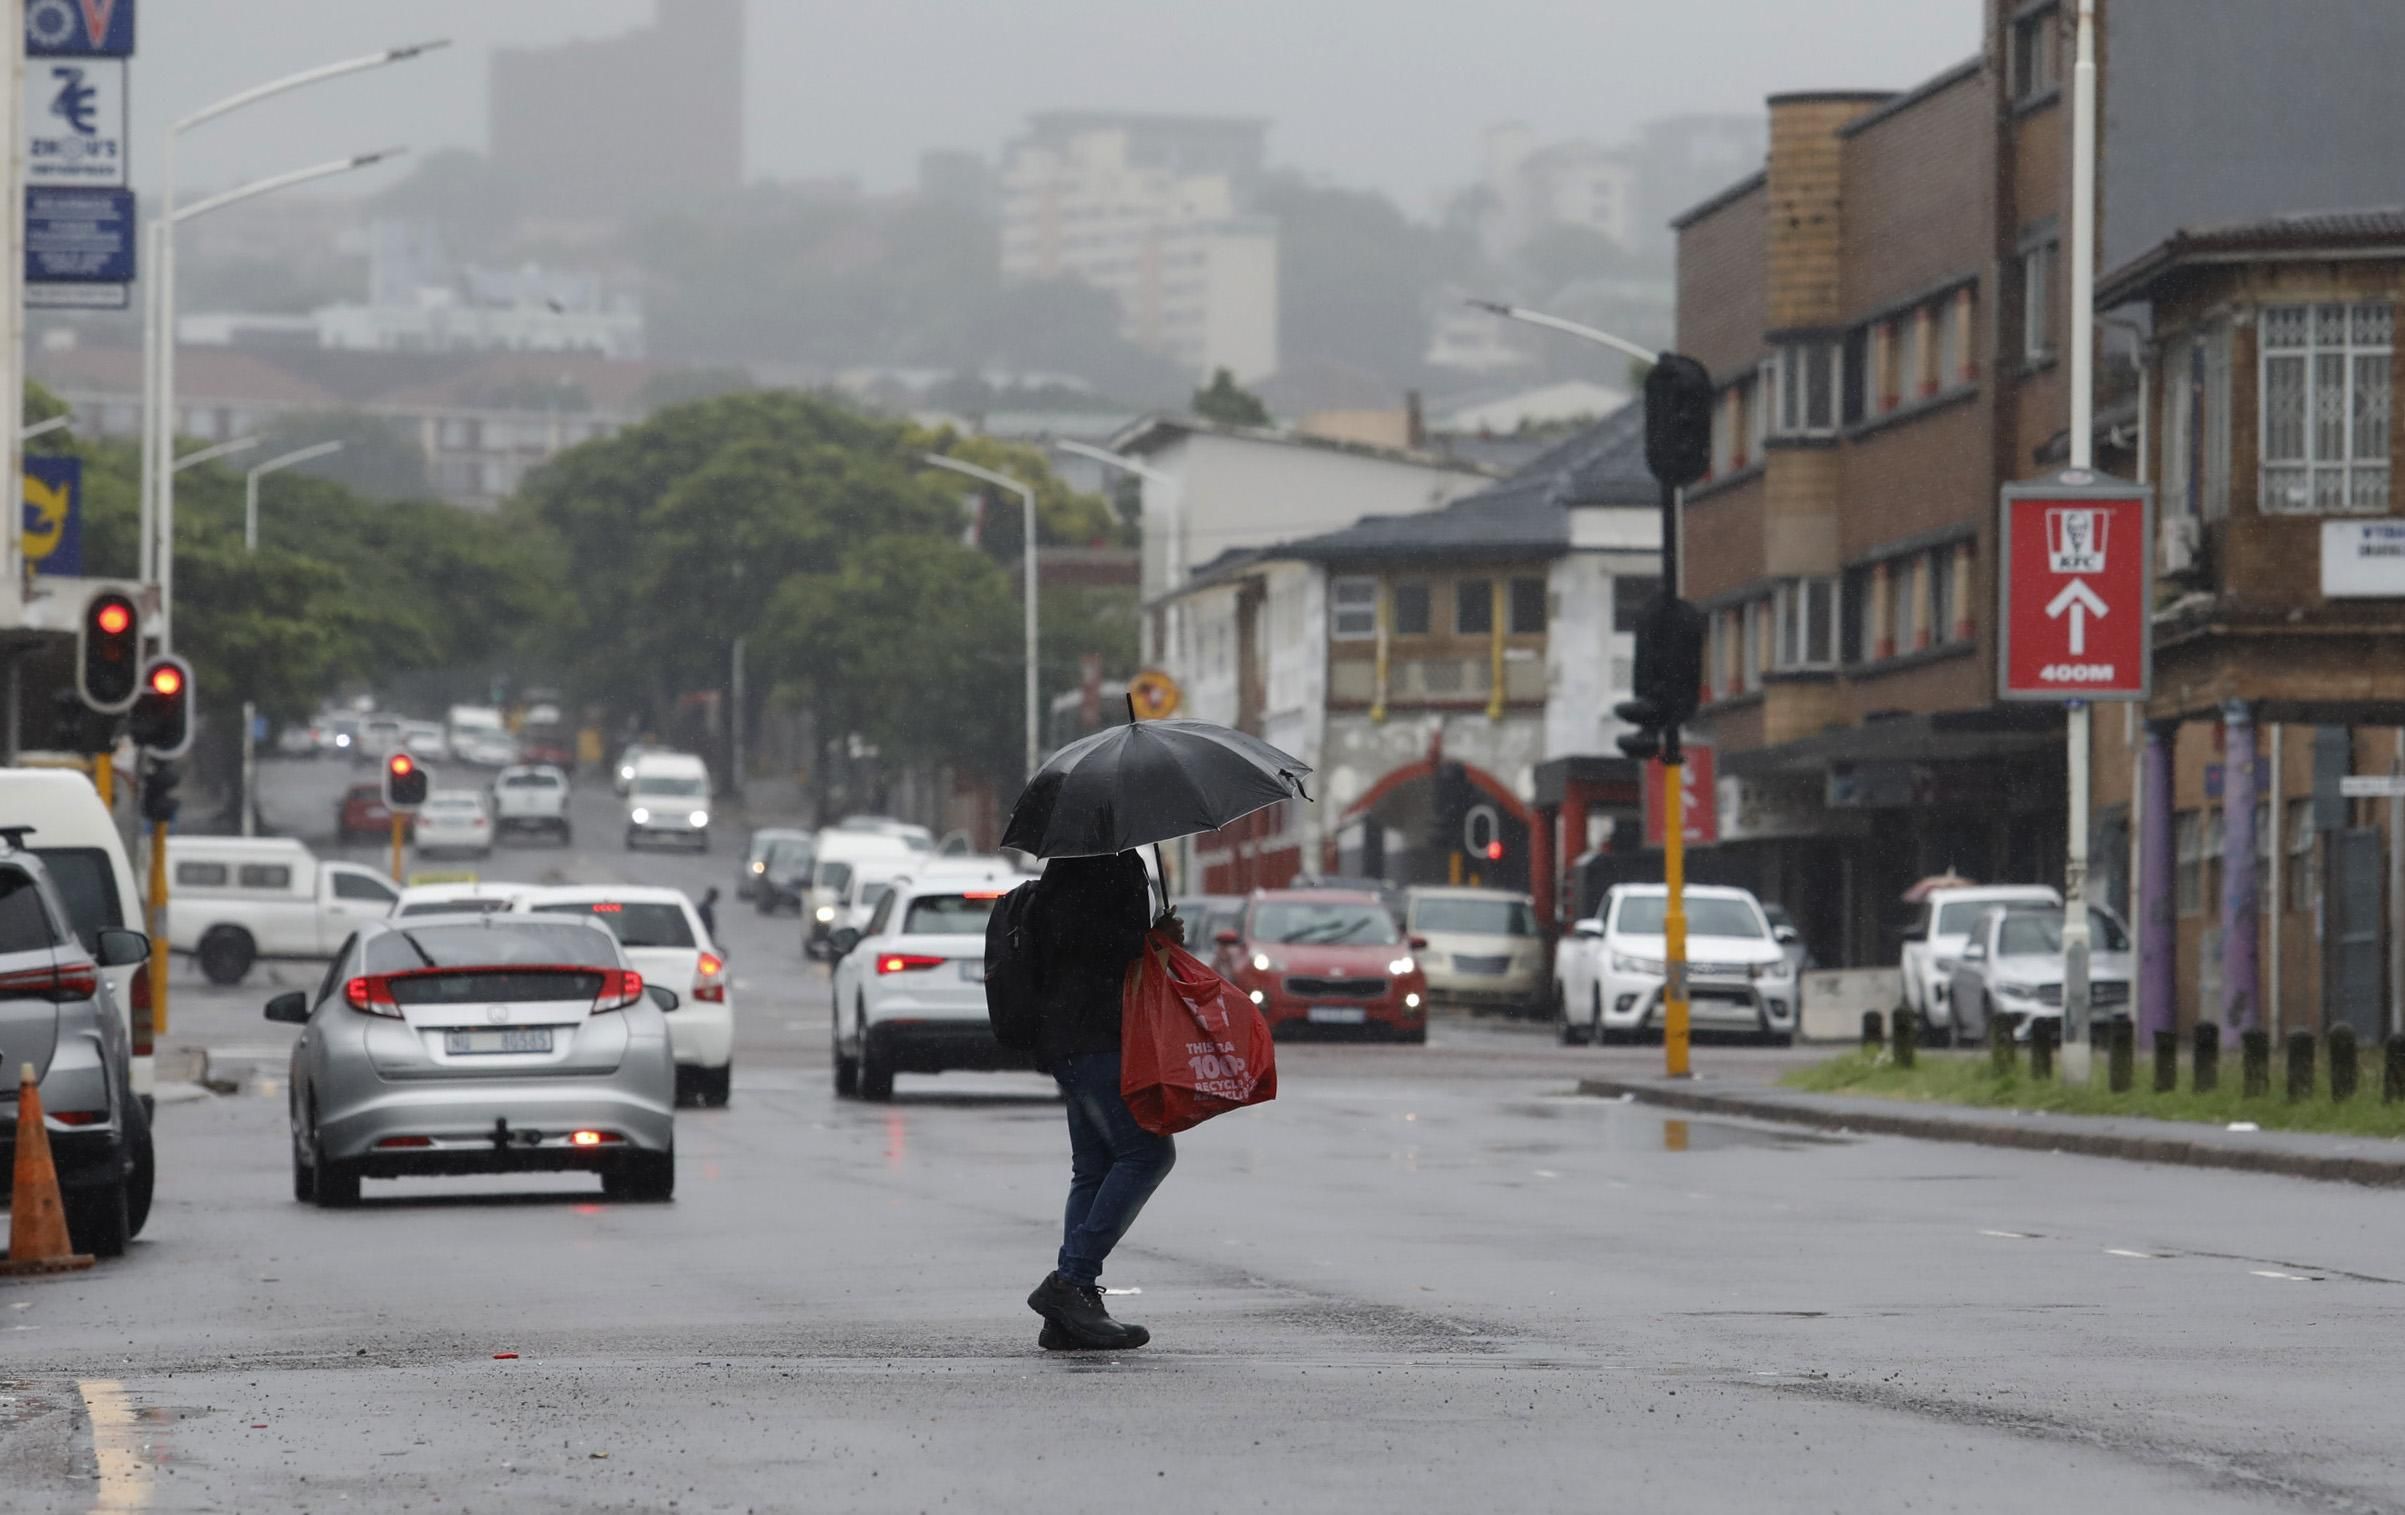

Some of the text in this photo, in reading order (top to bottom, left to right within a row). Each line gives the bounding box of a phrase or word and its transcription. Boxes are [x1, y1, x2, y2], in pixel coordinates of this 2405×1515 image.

[2060, 556, 2094, 568] KFC
[2039, 664, 2115, 681] 400M
[1186, 1042, 1215, 1054] THIS
